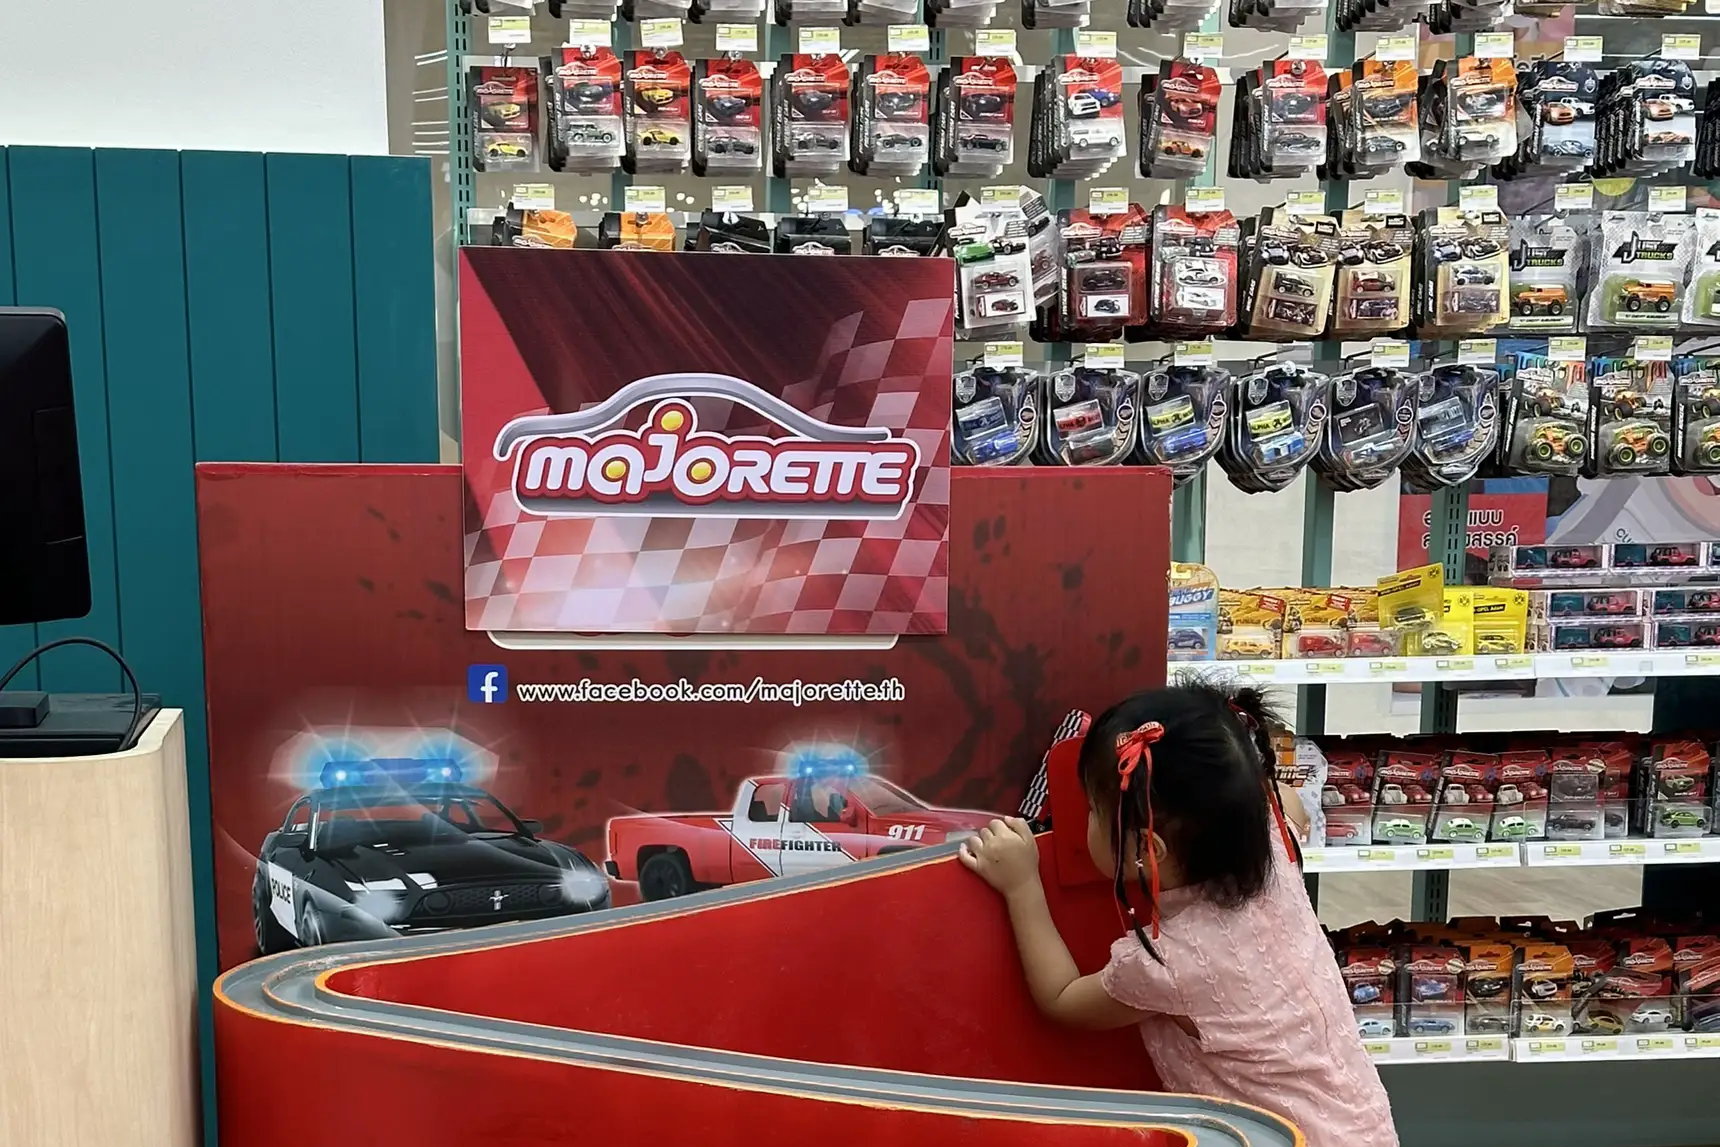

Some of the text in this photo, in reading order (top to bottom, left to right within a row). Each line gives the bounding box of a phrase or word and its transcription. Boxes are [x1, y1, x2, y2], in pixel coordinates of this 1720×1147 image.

[516, 677, 905, 707] www.facebook.com/majorette.th
[888, 824, 926, 841] 911
[749, 837, 843, 853] FIREFIGHTER
[270, 876, 293, 905] POLICE
